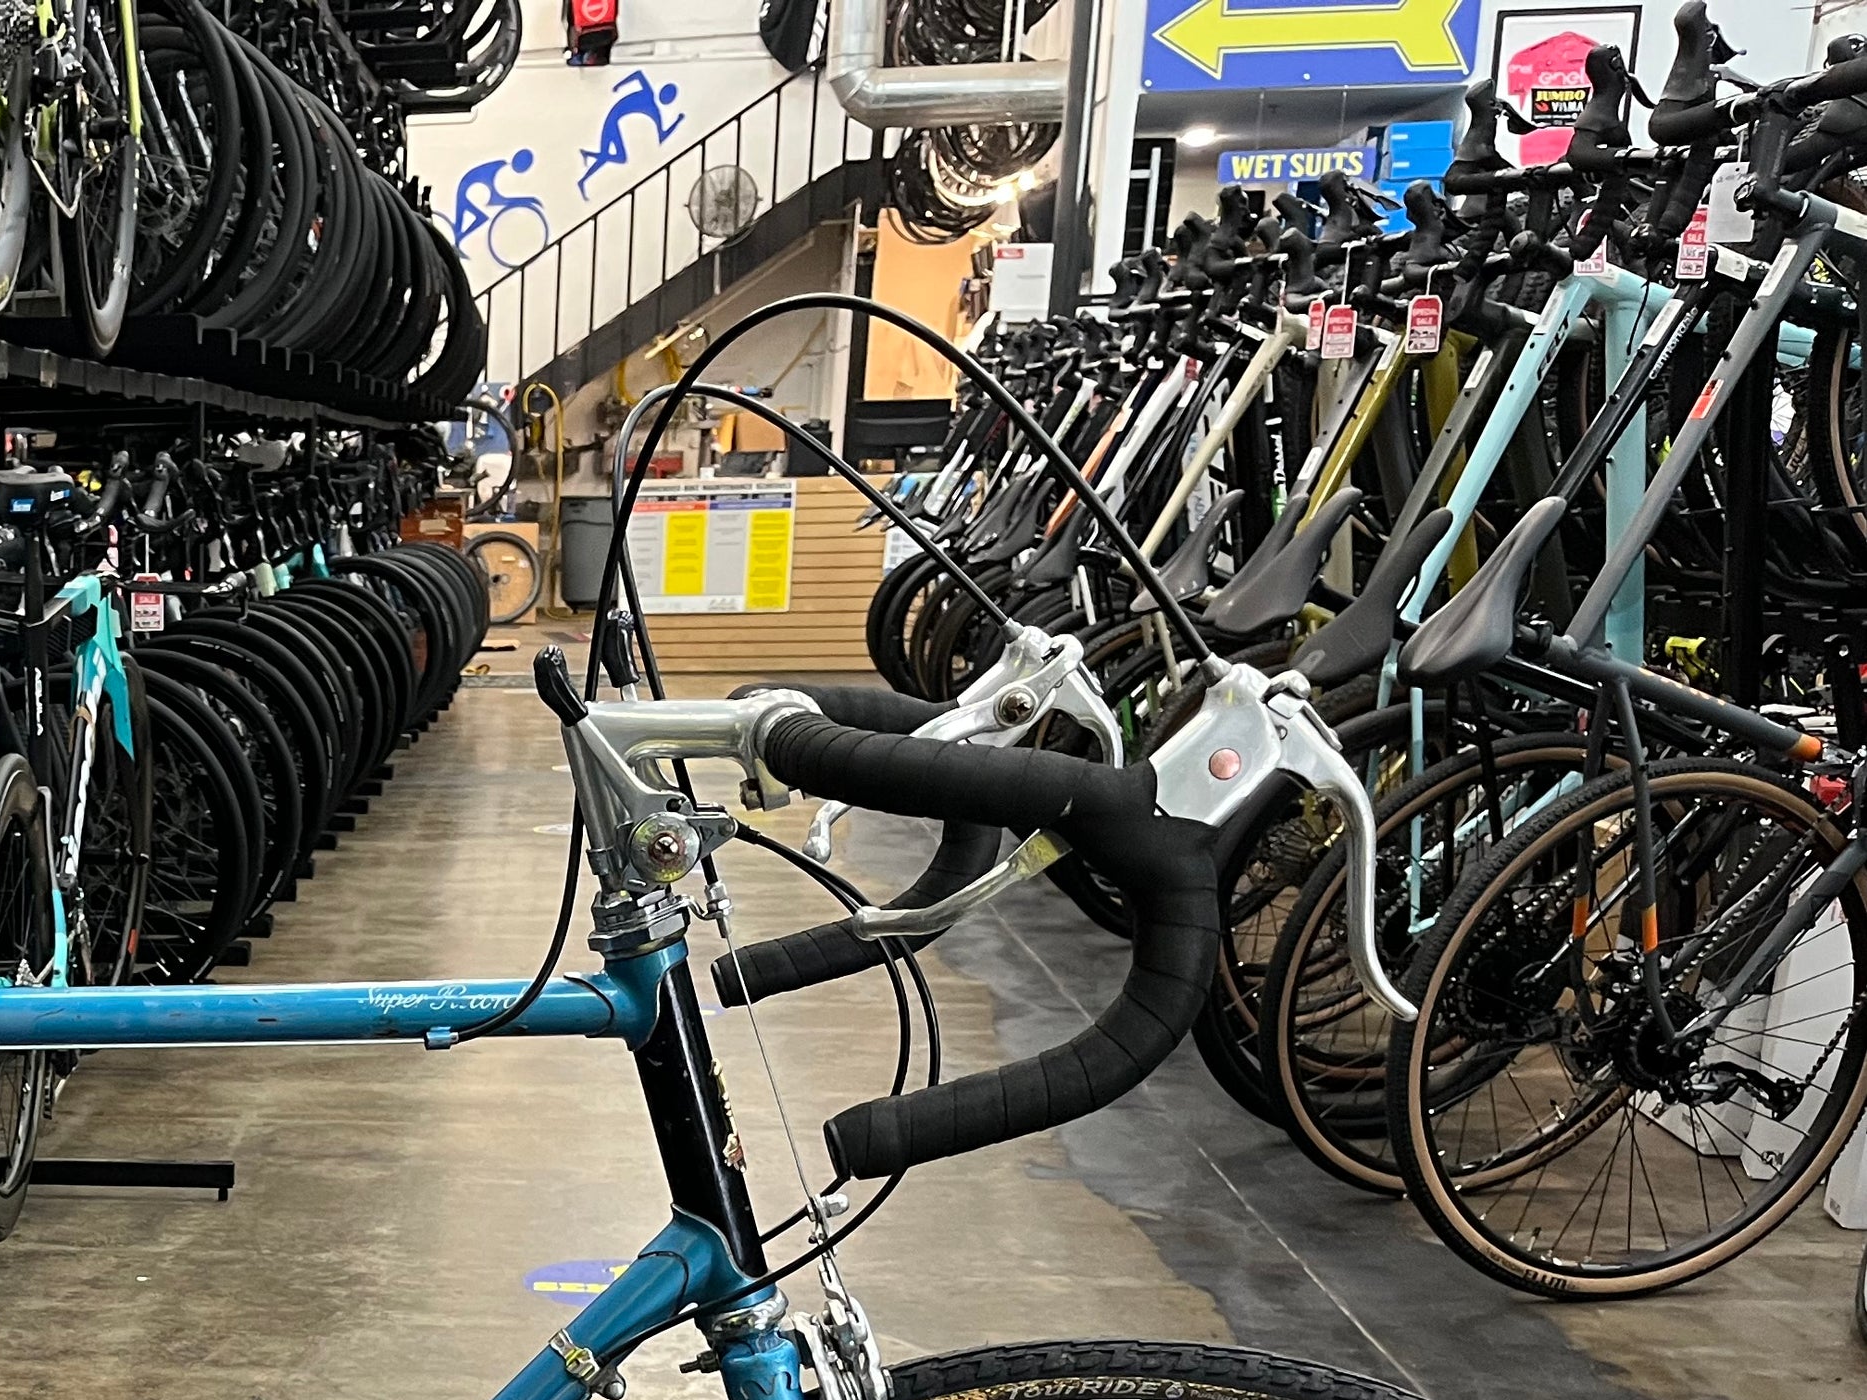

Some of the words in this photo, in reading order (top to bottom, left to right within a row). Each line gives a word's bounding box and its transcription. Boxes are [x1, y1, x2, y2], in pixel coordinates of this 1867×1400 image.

[1538, 67, 1584, 85] enel
[1535, 90, 1586, 102] JUMBO
[1231, 154, 1287, 180] WET
[1289, 151, 1364, 178] SUITS
[358, 986, 429, 1015] Super
[429, 984, 530, 1011] Rcord
